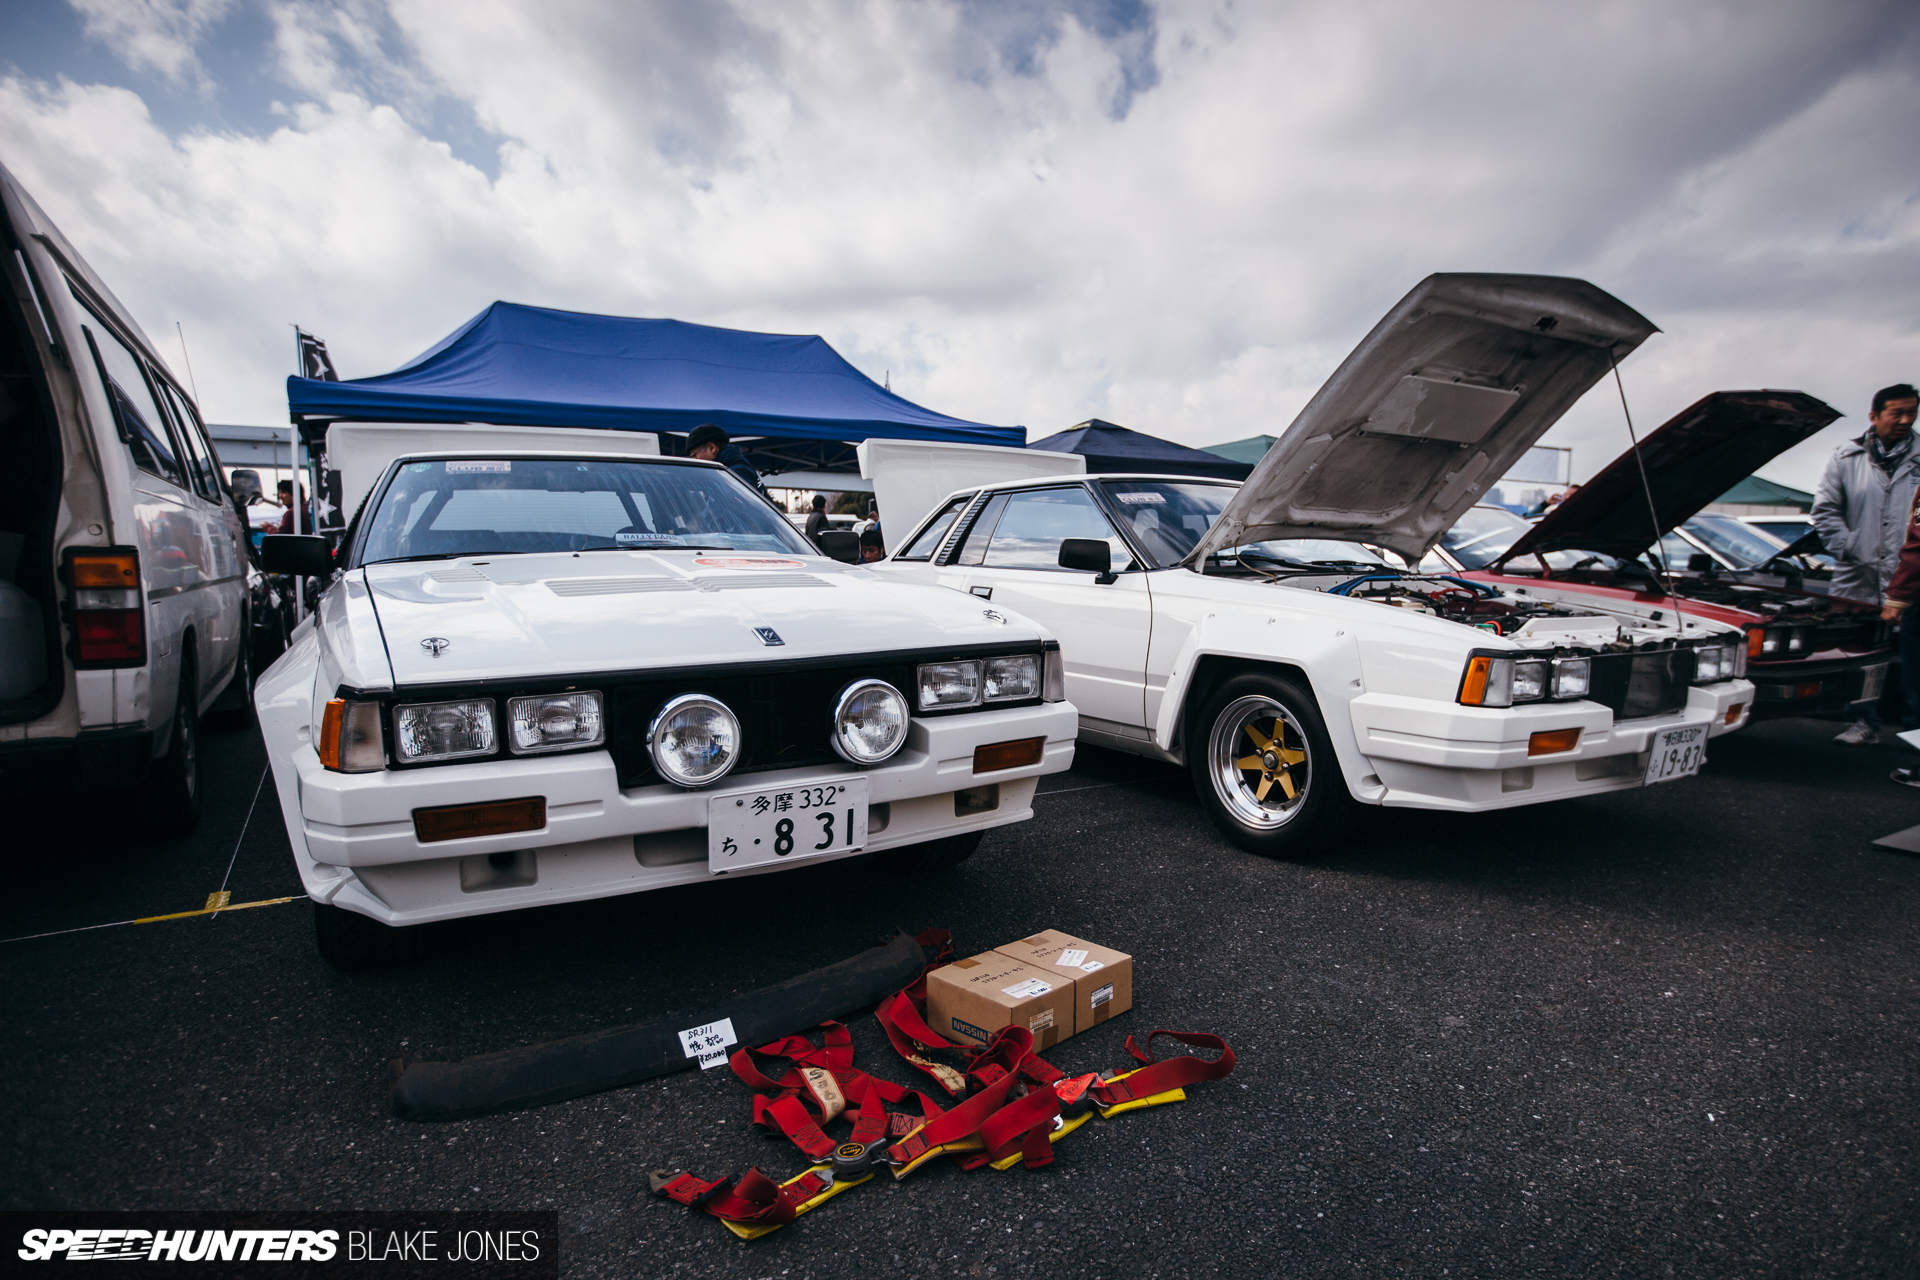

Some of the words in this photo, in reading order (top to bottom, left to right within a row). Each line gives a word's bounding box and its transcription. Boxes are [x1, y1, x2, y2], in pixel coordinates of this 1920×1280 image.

[1659, 745, 1700, 778] 19-83
[751, 793, 794, 816] 多摩
[799, 786, 837, 809] 332
[722, 837, 738, 856] ち
[688, 1025, 713, 1040] SR311
[953, 1020, 987, 1042] NISSAN
